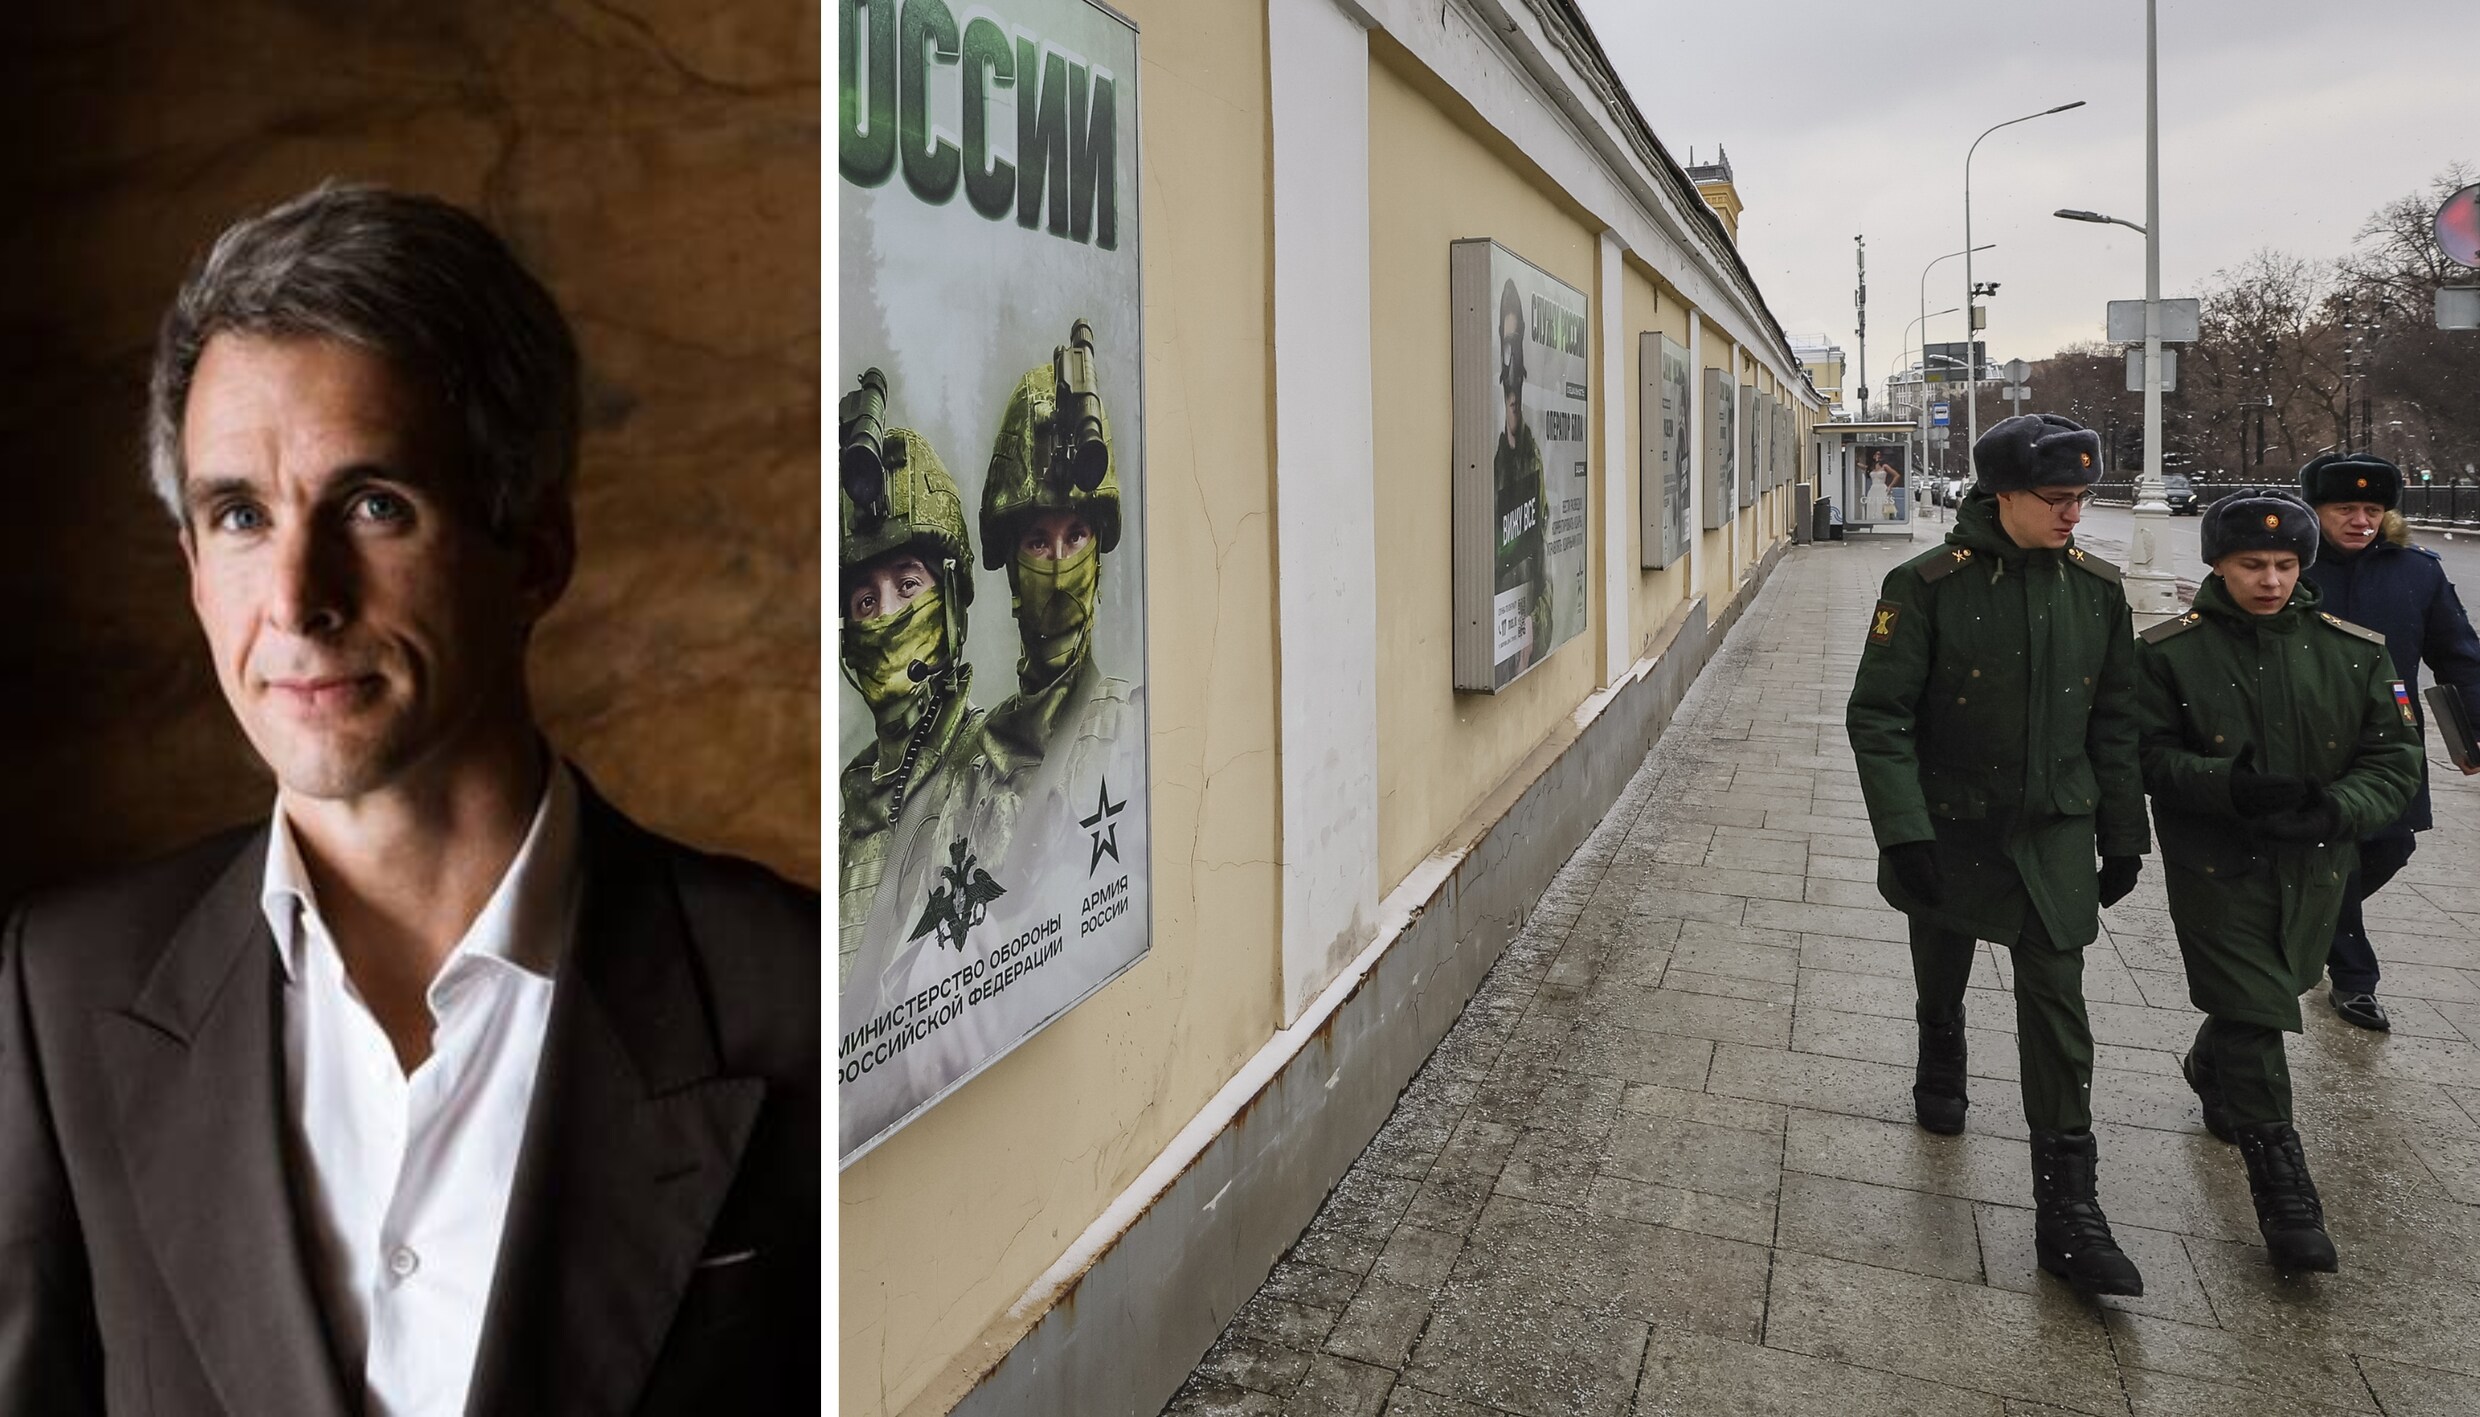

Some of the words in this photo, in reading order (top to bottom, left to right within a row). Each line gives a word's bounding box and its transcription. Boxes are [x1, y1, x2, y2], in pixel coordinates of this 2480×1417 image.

[1503, 504, 1523, 546] ВИЖУ
[1524, 497, 1536, 532] ВСЕ
[1081, 874, 1128, 916] АРМИЯ
[1081, 896, 1129, 938] РОССИИ
[839, 959, 985, 1060] МИНИСТЕРСТВО
[989, 913, 1062, 969] ОБОРОНЫ
[968, 936, 1063, 1006] ФЕДЕРАЦИИ
